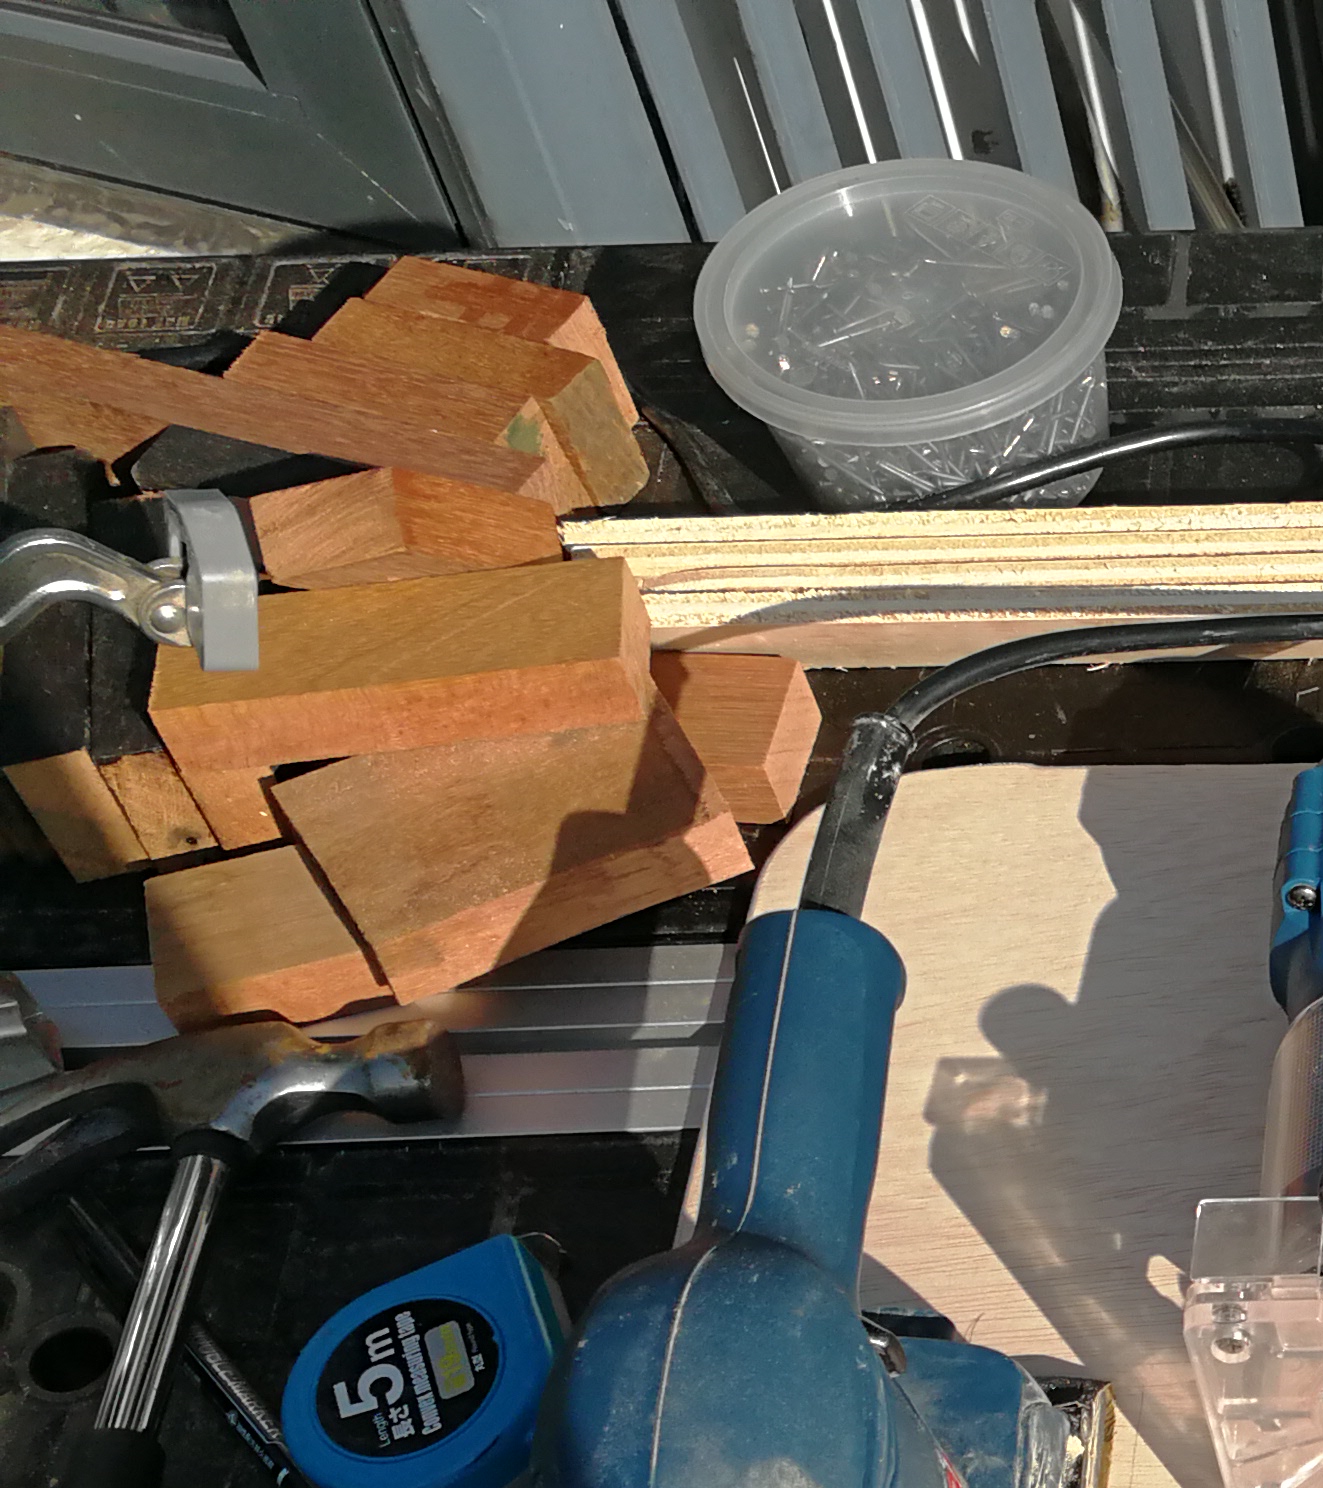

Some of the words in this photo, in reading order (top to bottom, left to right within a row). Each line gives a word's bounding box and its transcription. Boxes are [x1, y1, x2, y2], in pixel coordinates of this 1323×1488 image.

[395, 1310, 416, 1339] tape
[401, 1334, 432, 1396] measuring
[372, 1412, 391, 1449] Length
[417, 1391, 443, 1436] Convex
